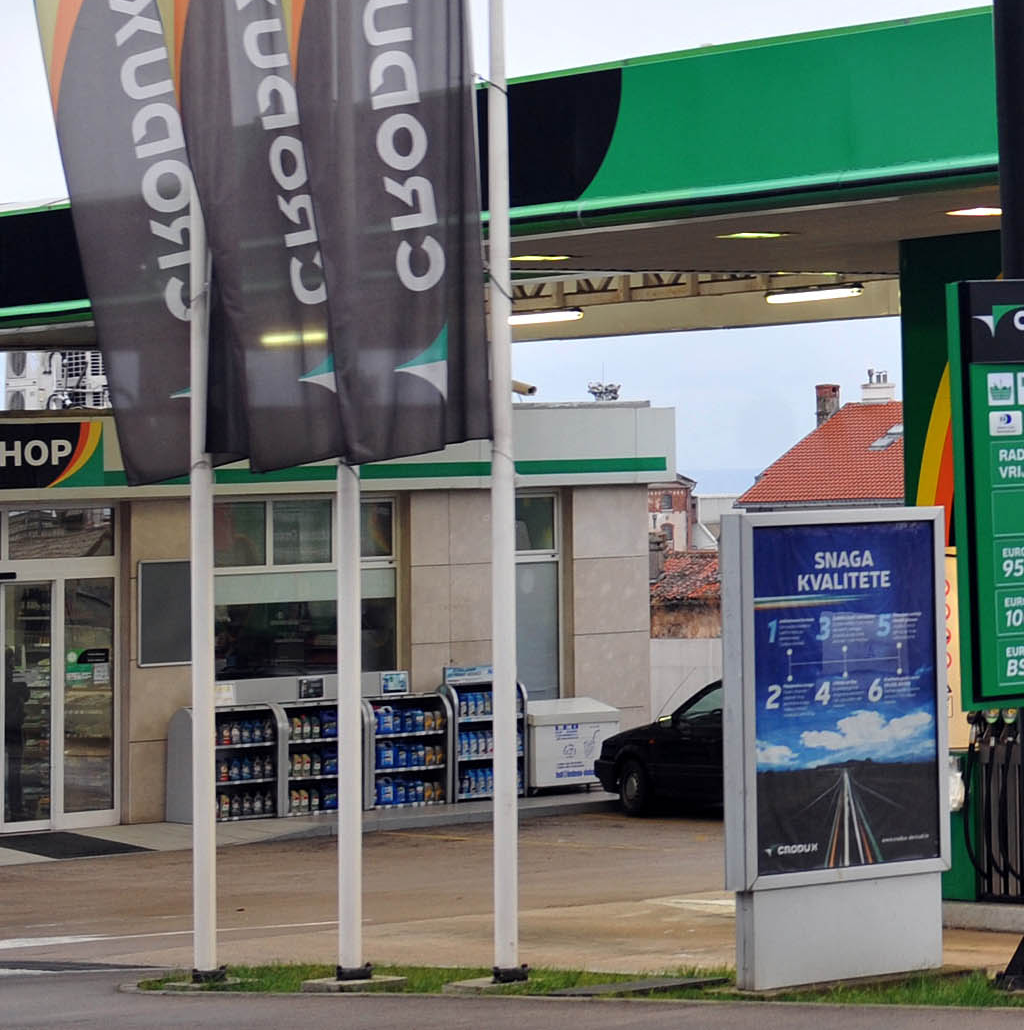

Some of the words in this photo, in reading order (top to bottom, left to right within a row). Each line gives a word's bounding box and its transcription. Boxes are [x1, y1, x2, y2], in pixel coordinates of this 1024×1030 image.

[814, 549, 875, 569] SNAGA
[1002, 559, 1024, 577] 95
[797, 570, 892, 591] KVALITETE
[767, 619, 778, 643] 1
[816, 616, 832, 641] 3
[876, 613, 891, 637] 5
[765, 684, 782, 710] 2
[814, 681, 831, 706] 4
[868, 678, 883, 703] 6
[777, 842, 819, 855] CRODUX
